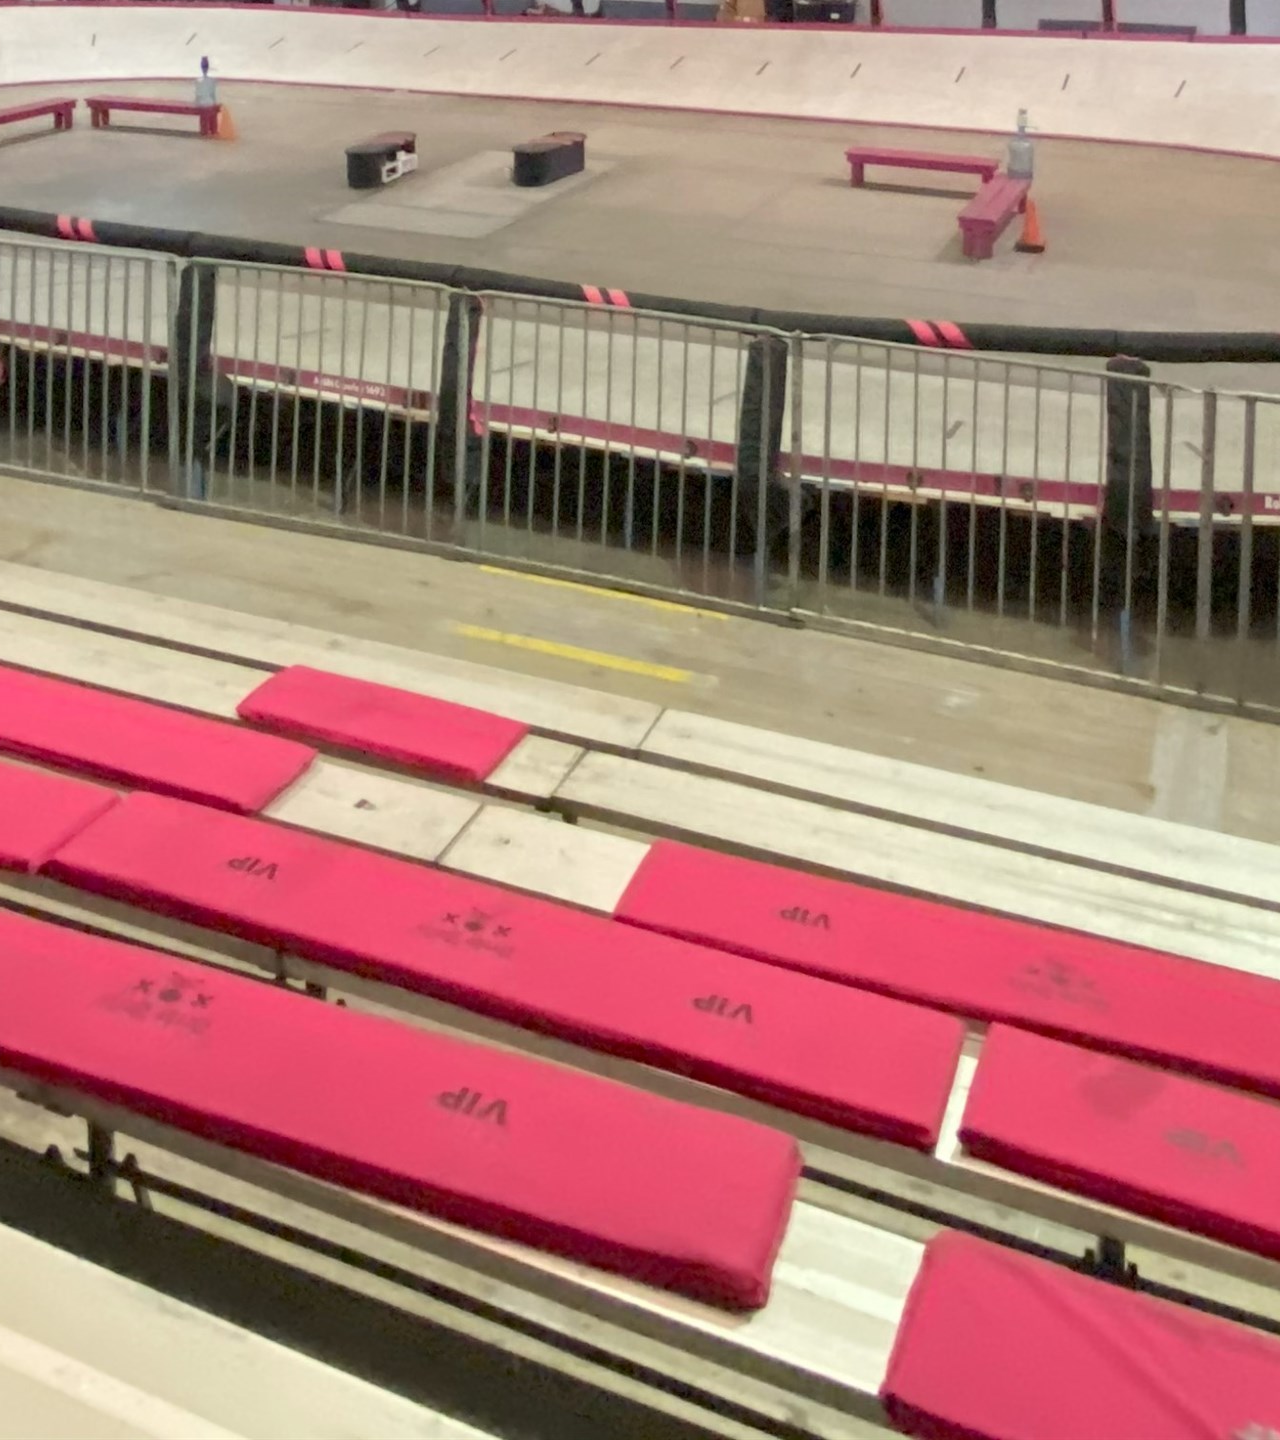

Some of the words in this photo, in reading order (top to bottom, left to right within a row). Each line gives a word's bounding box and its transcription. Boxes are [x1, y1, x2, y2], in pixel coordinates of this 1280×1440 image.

[227, 857, 279, 880] VIP
[780, 906, 830, 931] VIP
[693, 994, 753, 1024] VIP
[436, 1087, 508, 1127] VIP
